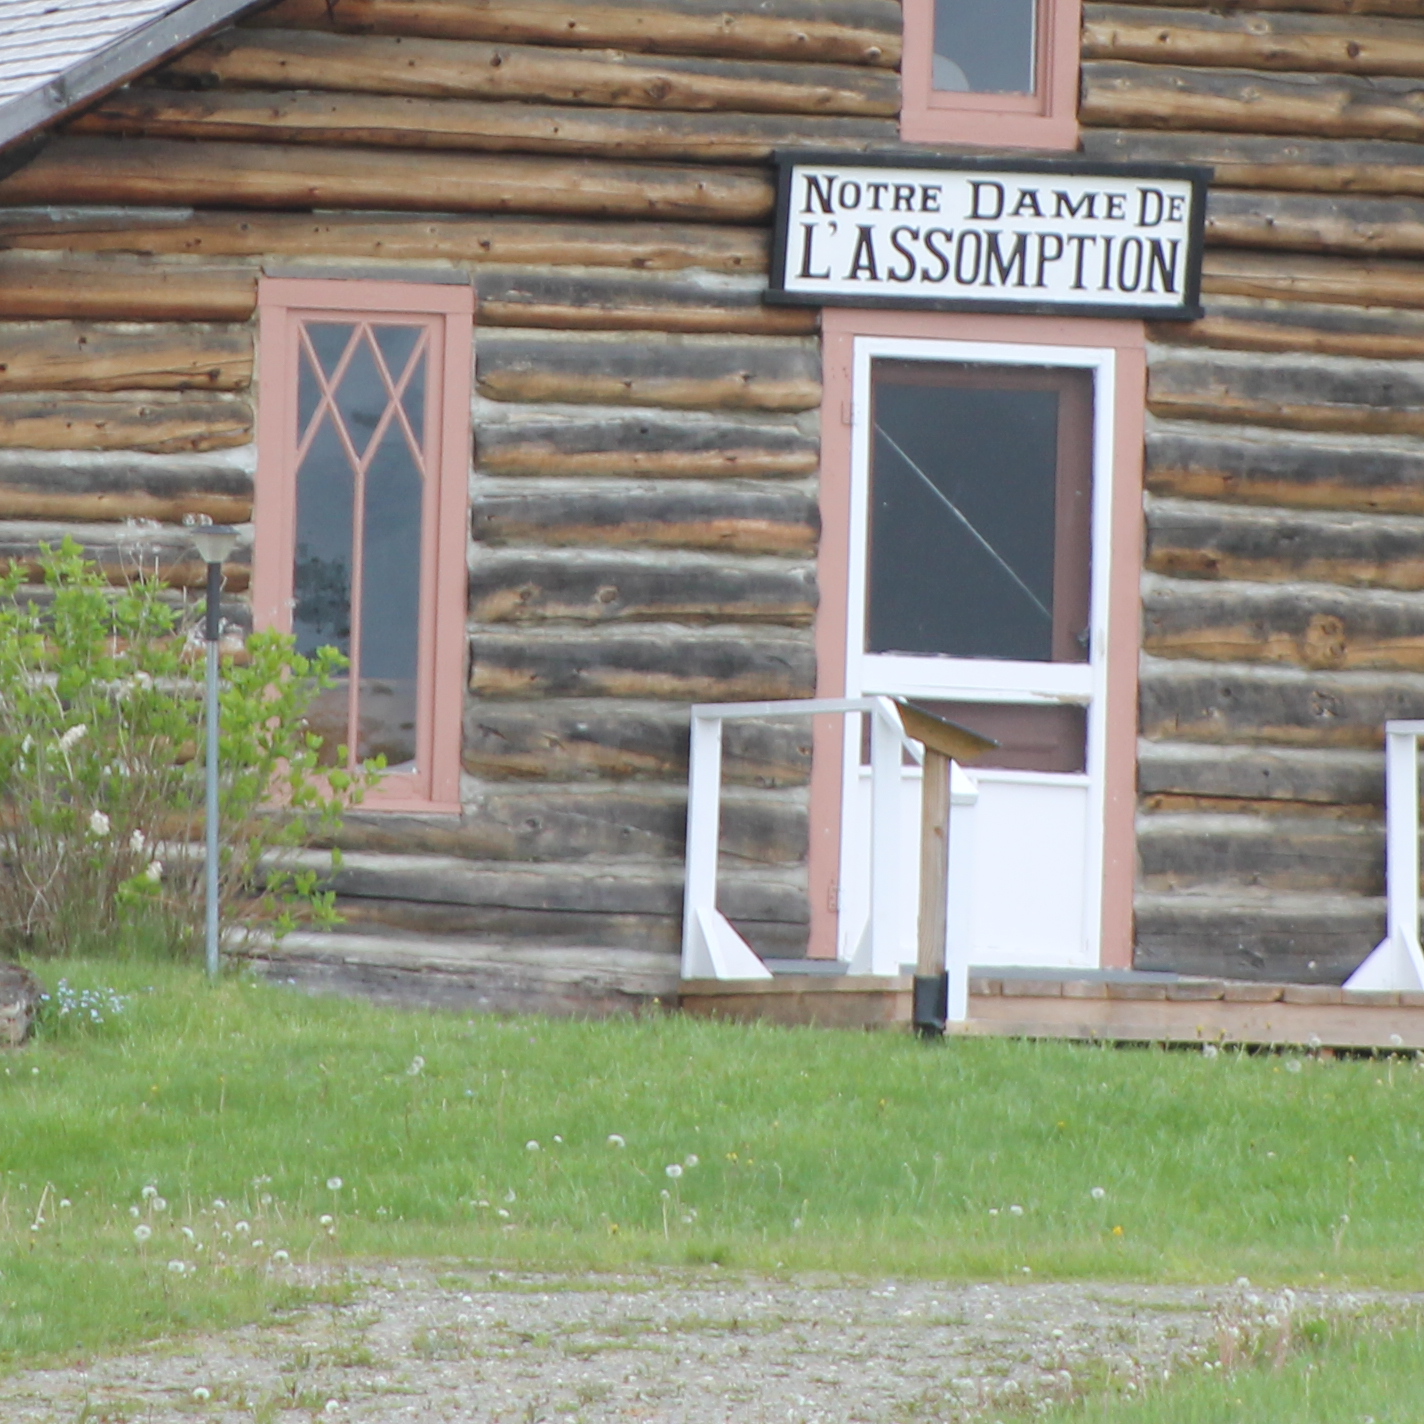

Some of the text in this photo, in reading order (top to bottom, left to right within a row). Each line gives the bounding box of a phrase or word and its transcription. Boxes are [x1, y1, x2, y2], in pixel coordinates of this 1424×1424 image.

[799, 174, 1186, 228] NOTRE DAME DE
[794, 221, 1184, 294] L'ASSOMPTION
